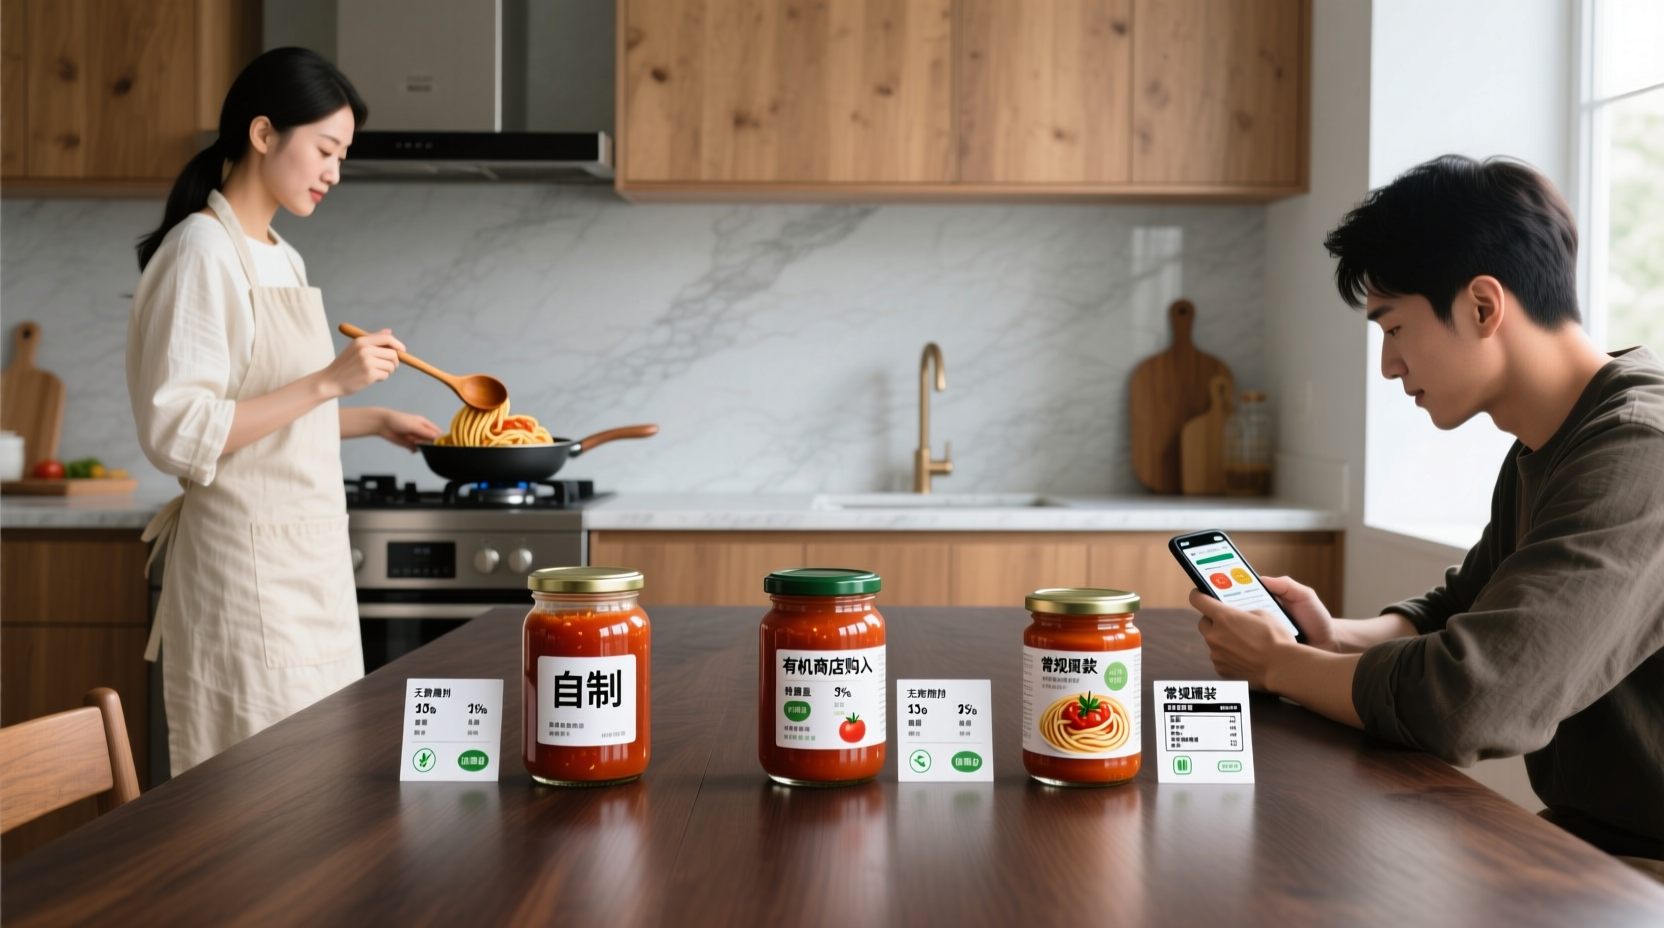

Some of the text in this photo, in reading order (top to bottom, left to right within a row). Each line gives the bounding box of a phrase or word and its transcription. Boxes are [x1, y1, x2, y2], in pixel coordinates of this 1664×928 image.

[782, 656, 873, 676] 有机商店购入
[554, 669, 622, 709] 自制
